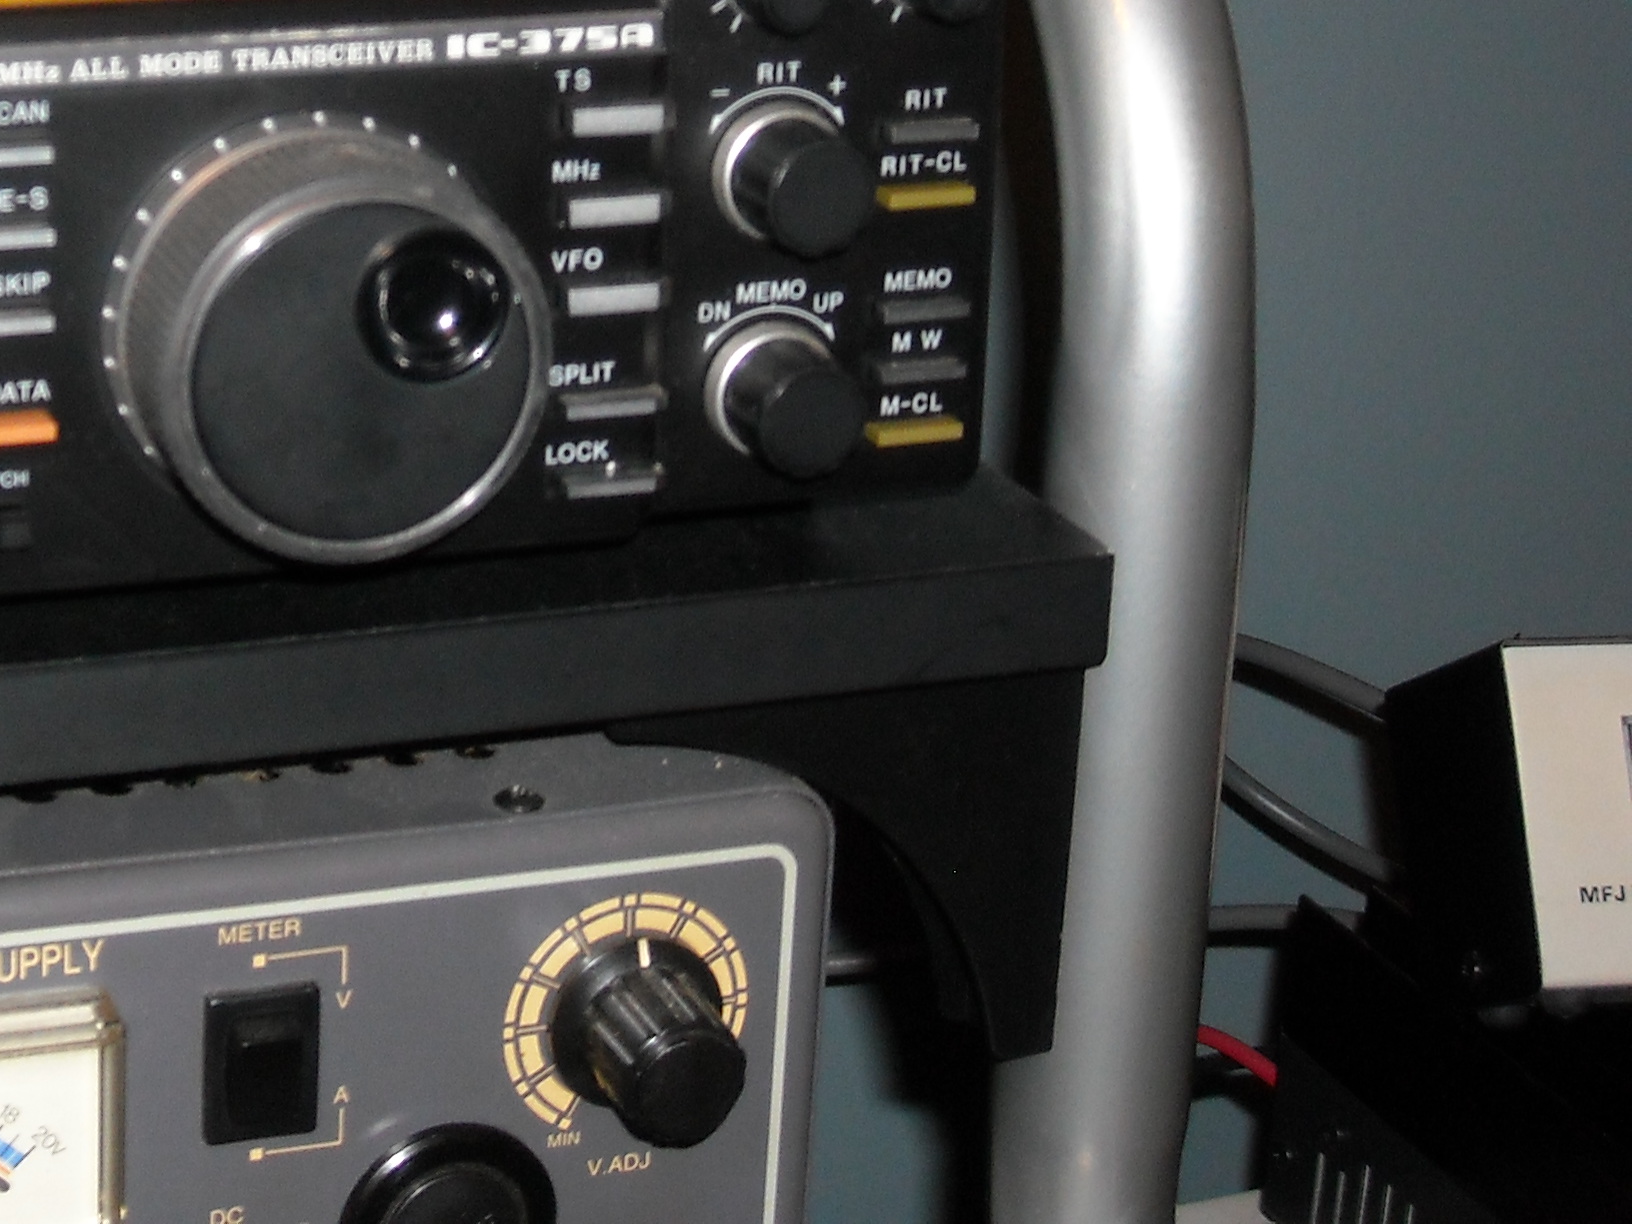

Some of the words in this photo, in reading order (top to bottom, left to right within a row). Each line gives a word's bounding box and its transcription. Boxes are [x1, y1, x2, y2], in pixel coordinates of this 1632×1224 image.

[70, 55, 126, 83] ALL
[139, 48, 221, 79] MODE
[232, 38, 433, 72] TRANSCEIVER
[446, 22, 654, 61] IC-375A
[756, 60, 802, 85] RIT
[904, 87, 948, 110] RIT
[551, 159, 602, 184] MHz
[880, 150, 968, 177] RIT-CL
[551, 247, 604, 274] VFO
[735, 279, 807, 304] MEMO
[884, 267, 953, 292] MEMO
[698, 301, 732, 324] DN
[812, 291, 845, 315] UP
[548, 359, 616, 387] SPLIT
[879, 392, 944, 416] M-CL
[545, 439, 610, 467] LOCK
[1579, 885, 1626, 904] MFJ
[217, 918, 303, 947] METER
[335, 988, 352, 1011] V
[332, 1085, 351, 1106] A
[0, 1103, 21, 1124] 18
[546, 1131, 582, 1149] MIN
[586, 1151, 653, 1177] V.ADJ
